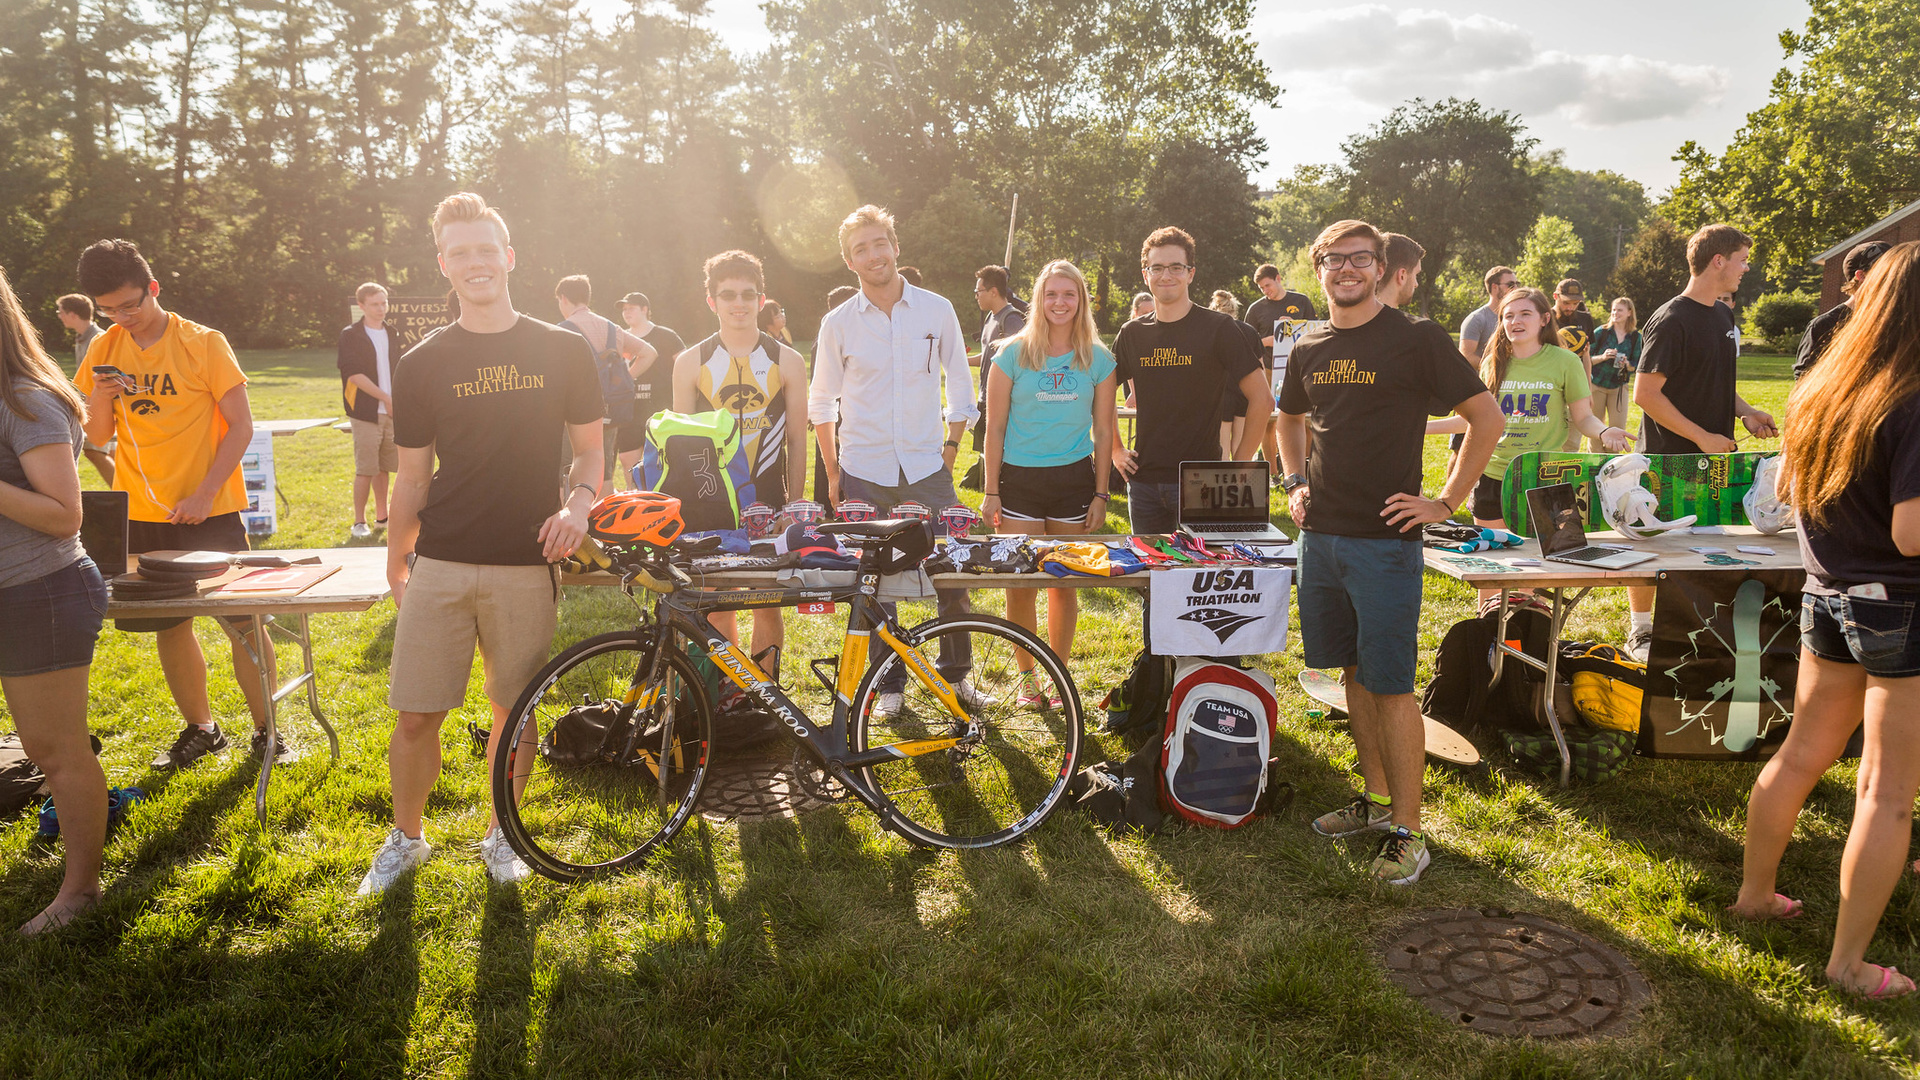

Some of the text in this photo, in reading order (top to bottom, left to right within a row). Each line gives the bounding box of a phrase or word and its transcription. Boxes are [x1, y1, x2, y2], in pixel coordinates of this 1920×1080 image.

[390, 303, 448, 313] NIVERSI
[406, 316, 449, 326] IOWA
[1139, 355, 1192, 367] TRIATHLON
[1153, 347, 1178, 359] IOWA
[476, 364, 520, 382] IOWA
[1328, 359, 1357, 373] IOWA
[112, 373, 178, 400] OWA
[452, 374, 545, 398] TRIATHLON
[1312, 370, 1377, 385] TRIATHLON
[1497, 393, 1551, 417] ALK
[1523, 414, 1550, 424] health
[688, 447, 718, 499] TYR
[1214, 473, 1248, 484] TEAM
[1210, 485, 1255, 509] USA
[642, 515, 667, 533] LAZER
[1191, 569, 1255, 594] USA
[808, 603, 825, 613] 83
[1185, 592, 1261, 607] TRIATHLON
[906, 648, 951, 696] QUINTANA ROO
[707, 638, 809, 738] QUINTANA ROO
[1205, 701, 1249, 720] TEAM USA
